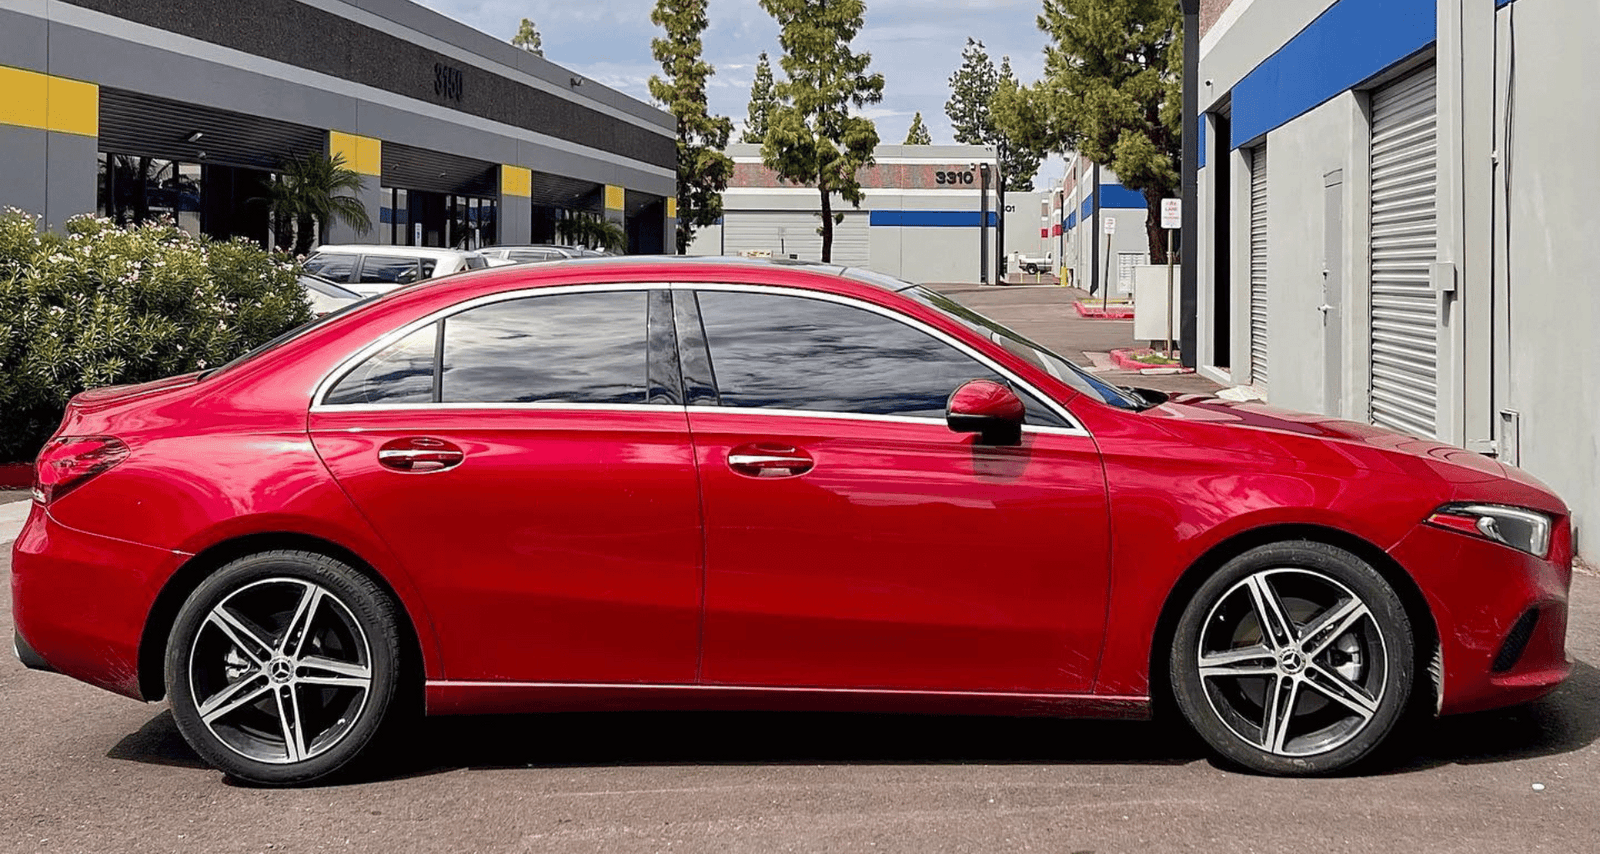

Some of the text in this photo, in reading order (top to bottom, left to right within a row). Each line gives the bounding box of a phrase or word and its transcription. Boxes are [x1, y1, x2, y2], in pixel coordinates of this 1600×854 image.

[434, 62, 463, 102] 3150
[935, 171, 974, 184] 3310
[1003, 205, 1015, 213] 01
